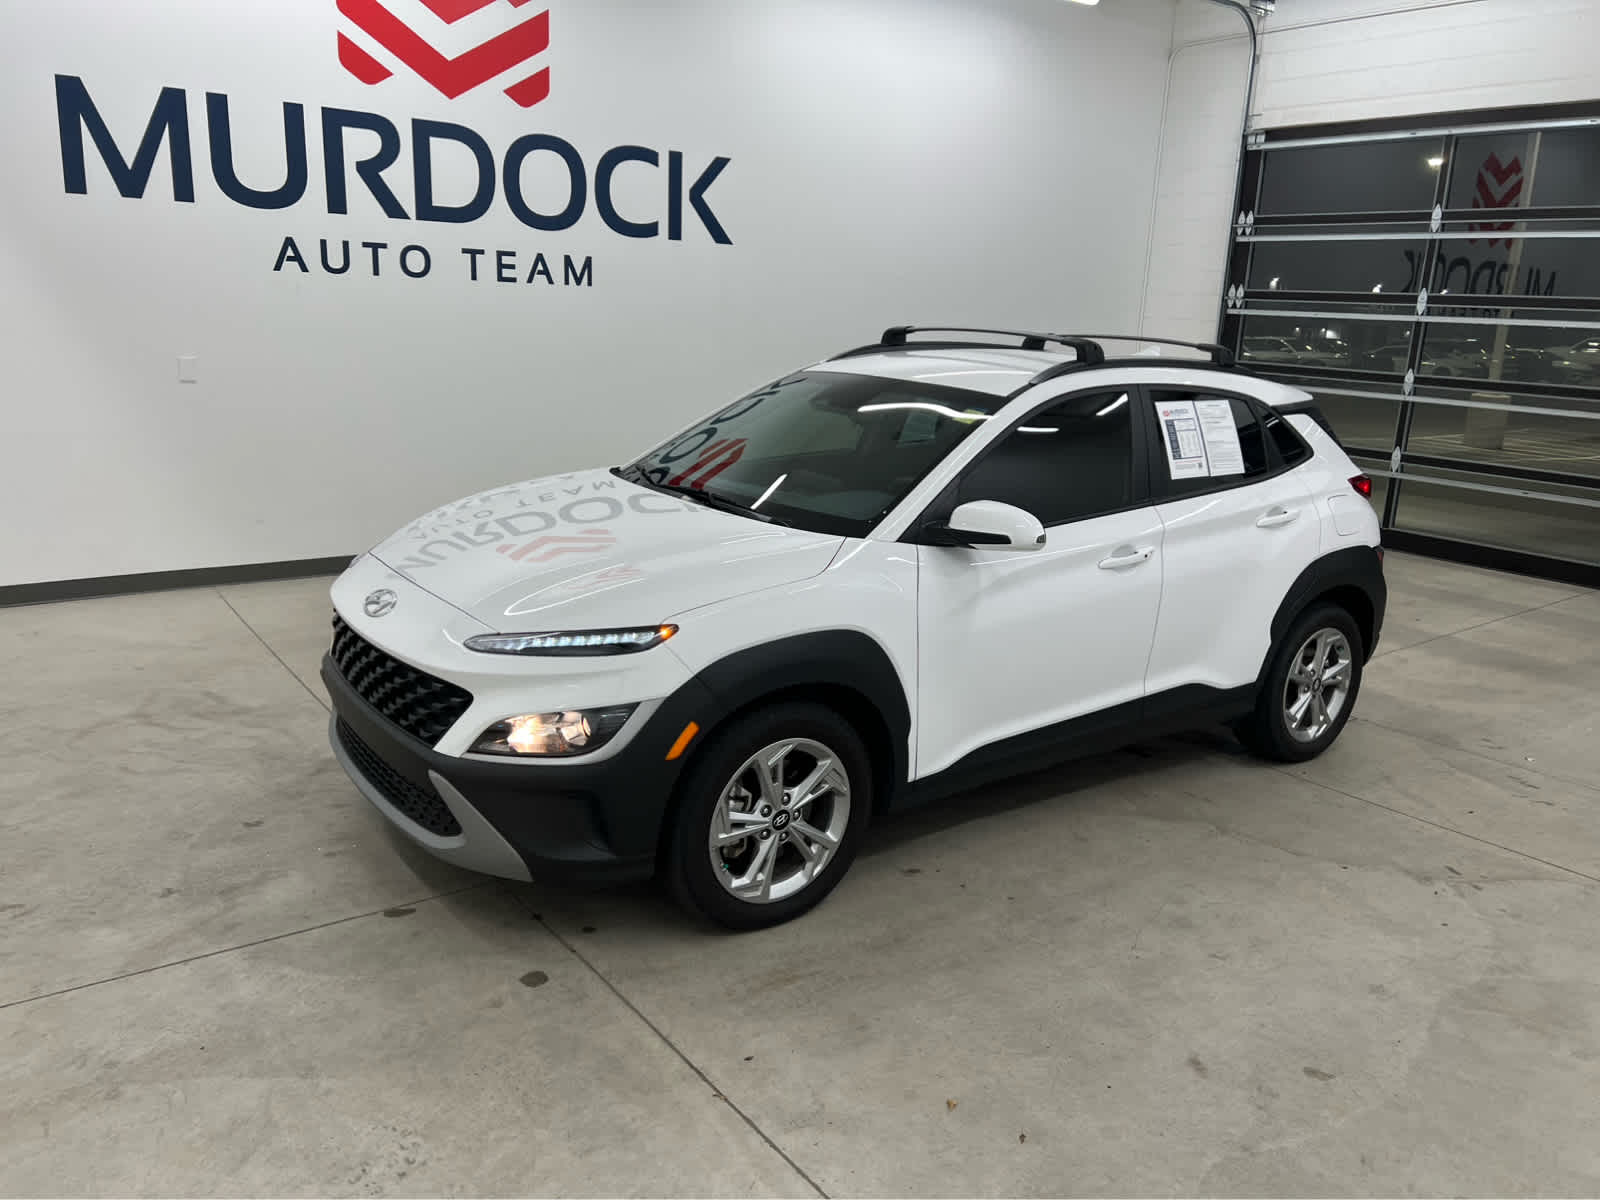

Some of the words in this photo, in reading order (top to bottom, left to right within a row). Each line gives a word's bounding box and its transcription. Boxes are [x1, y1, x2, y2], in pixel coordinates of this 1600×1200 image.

[54, 73, 733, 246] MURDOCK
[272, 236, 432, 279] AUTO
[461, 247, 593, 287] TEAM
